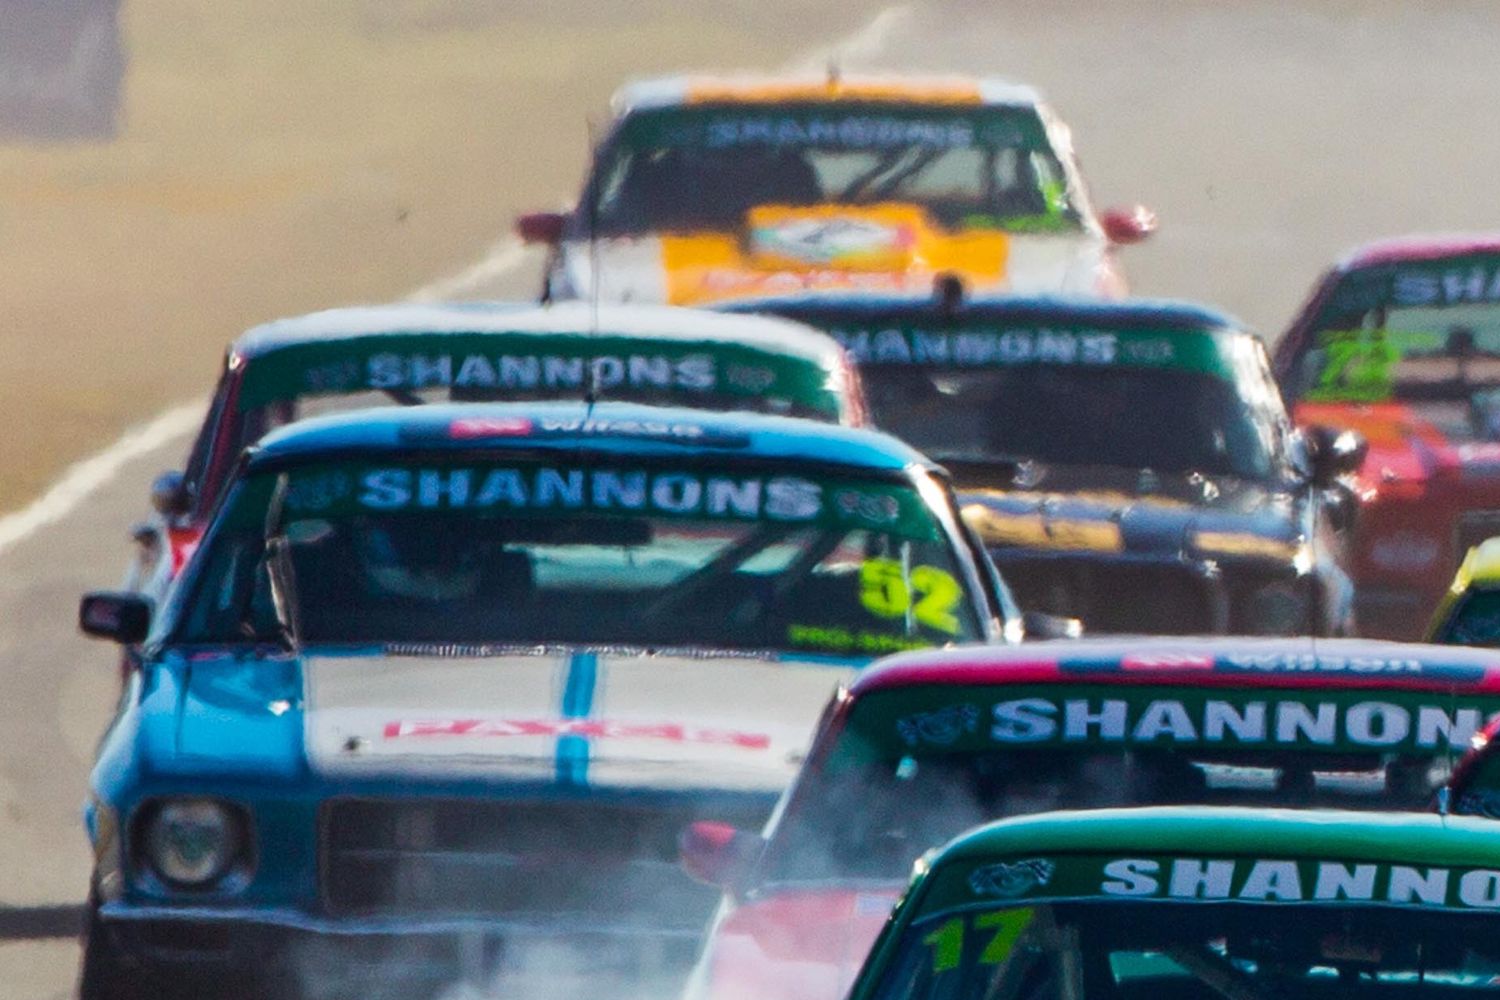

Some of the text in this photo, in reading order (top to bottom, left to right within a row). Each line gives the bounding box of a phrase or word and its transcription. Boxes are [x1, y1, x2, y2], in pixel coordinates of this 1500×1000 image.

[367, 352, 715, 390] SHANNONS
[360, 467, 824, 521] SHANNONS
[858, 557, 962, 635] 52
[922, 906, 1034, 973] 17
